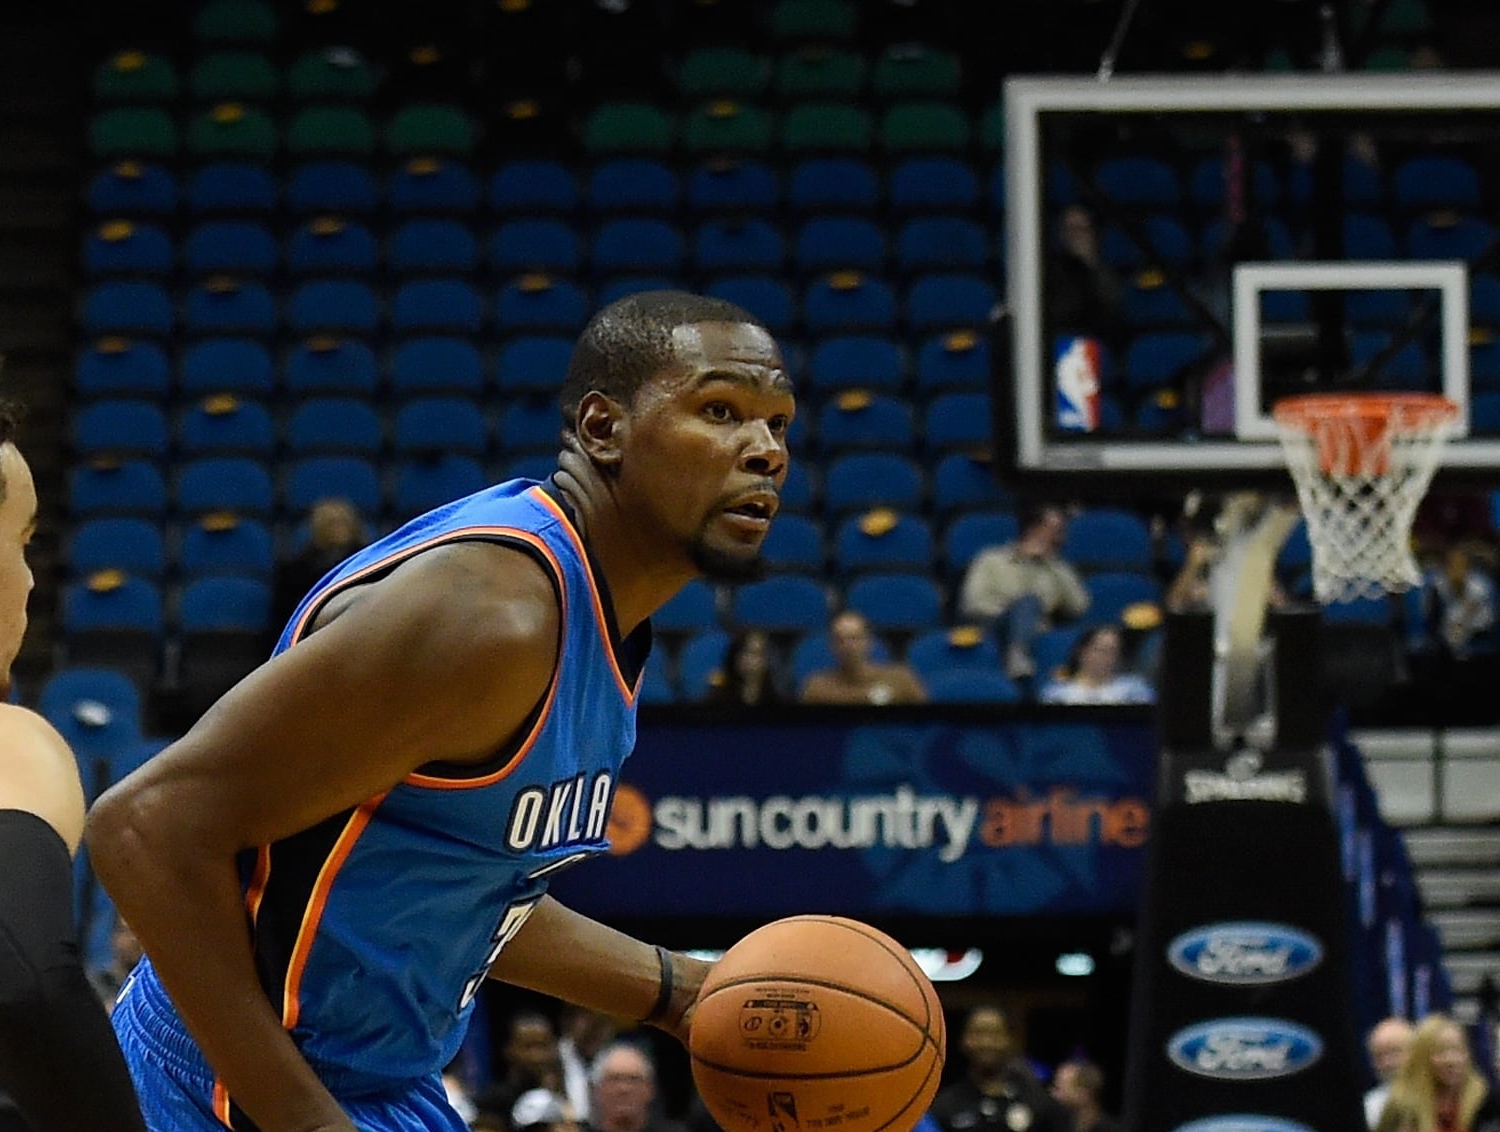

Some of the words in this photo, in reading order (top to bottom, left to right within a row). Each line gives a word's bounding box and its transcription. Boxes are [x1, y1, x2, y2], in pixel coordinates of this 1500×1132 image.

[506, 771, 613, 852] OKLA
[1197, 934, 1296, 975] Ford
[1197, 1030, 1295, 1071] Ford
